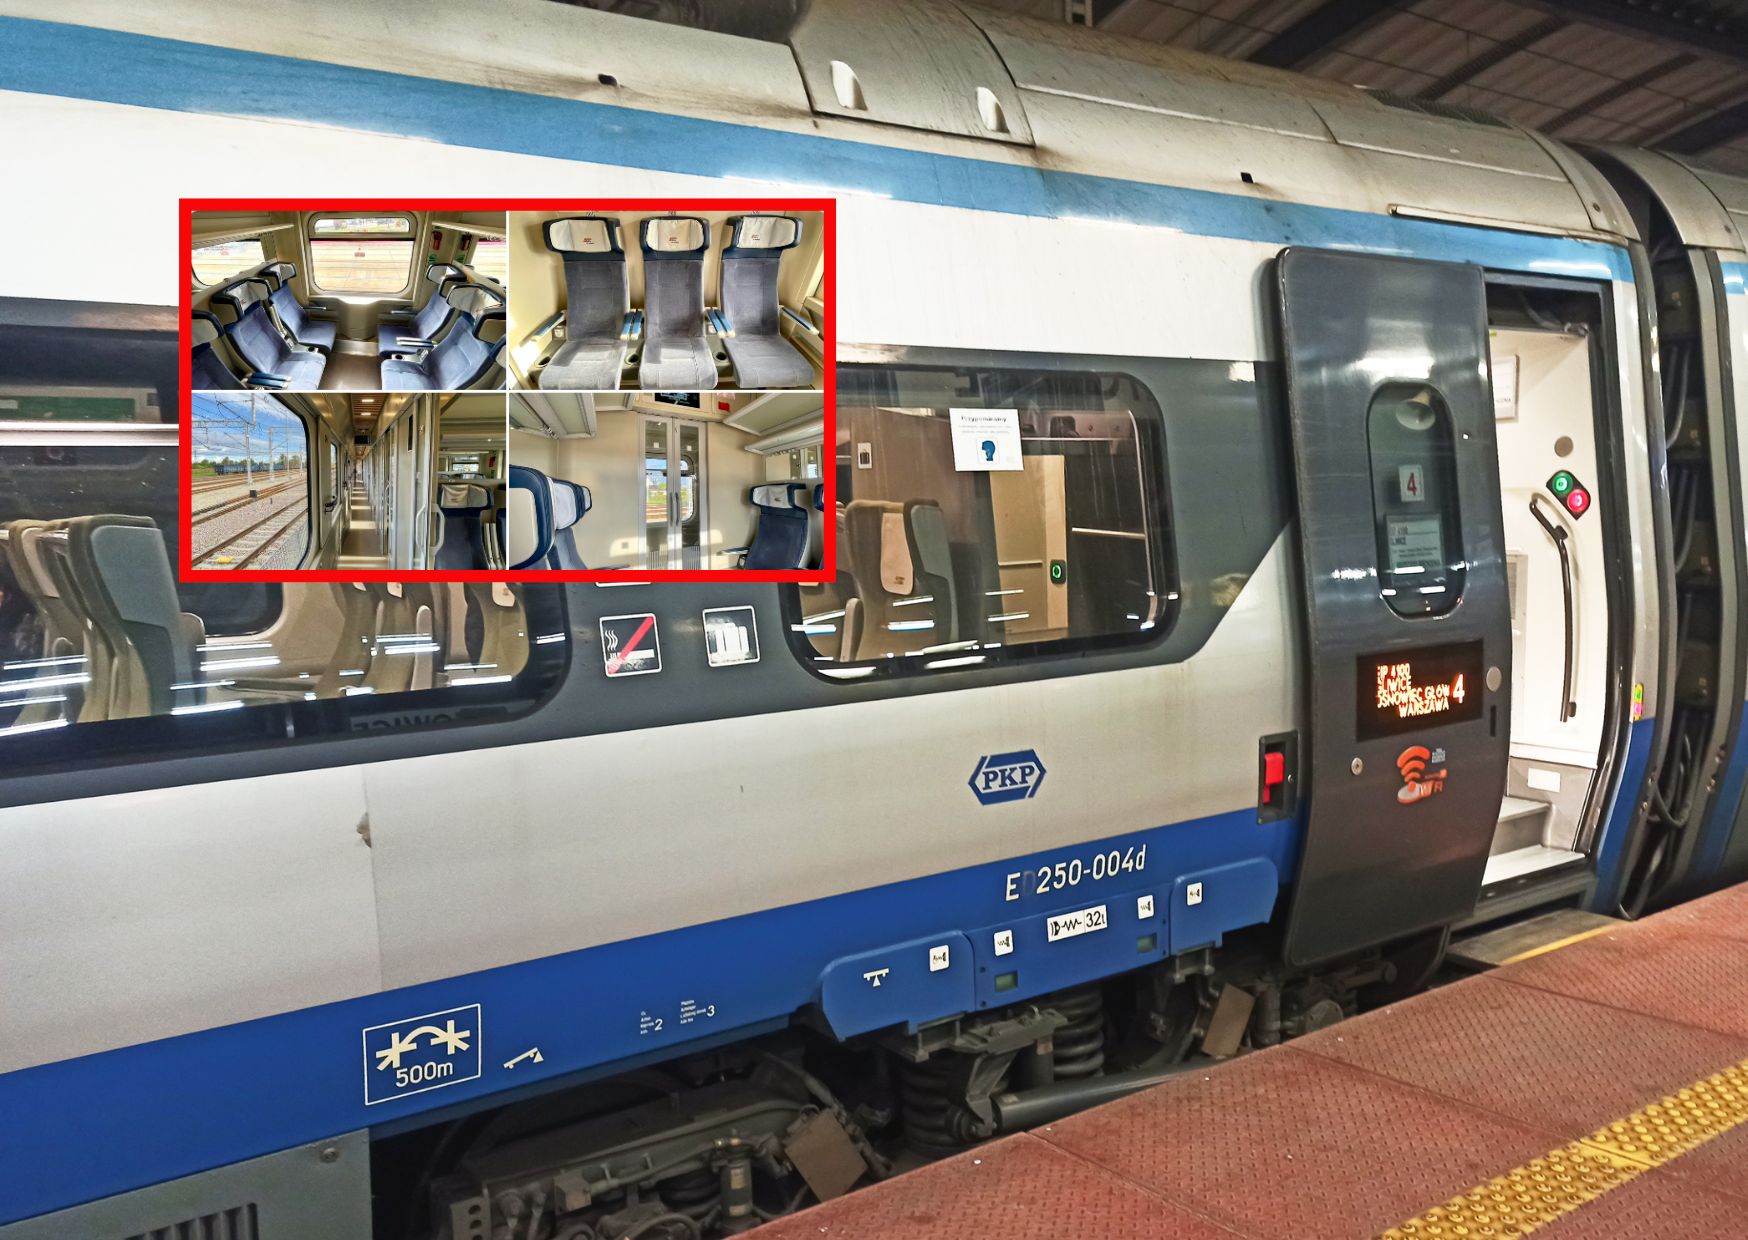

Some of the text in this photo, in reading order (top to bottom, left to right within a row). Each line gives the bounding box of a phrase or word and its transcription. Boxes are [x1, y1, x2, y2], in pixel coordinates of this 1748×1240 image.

[1406, 471, 1417, 496] 4
[1453, 673, 1465, 704] 4
[1399, 695, 1449, 718] WARSZAWA
[982, 764, 1035, 790] PKP
[706, 1004, 716, 1017] 3
[654, 1018, 664, 1032] 2
[395, 1059, 454, 1088] 500m
